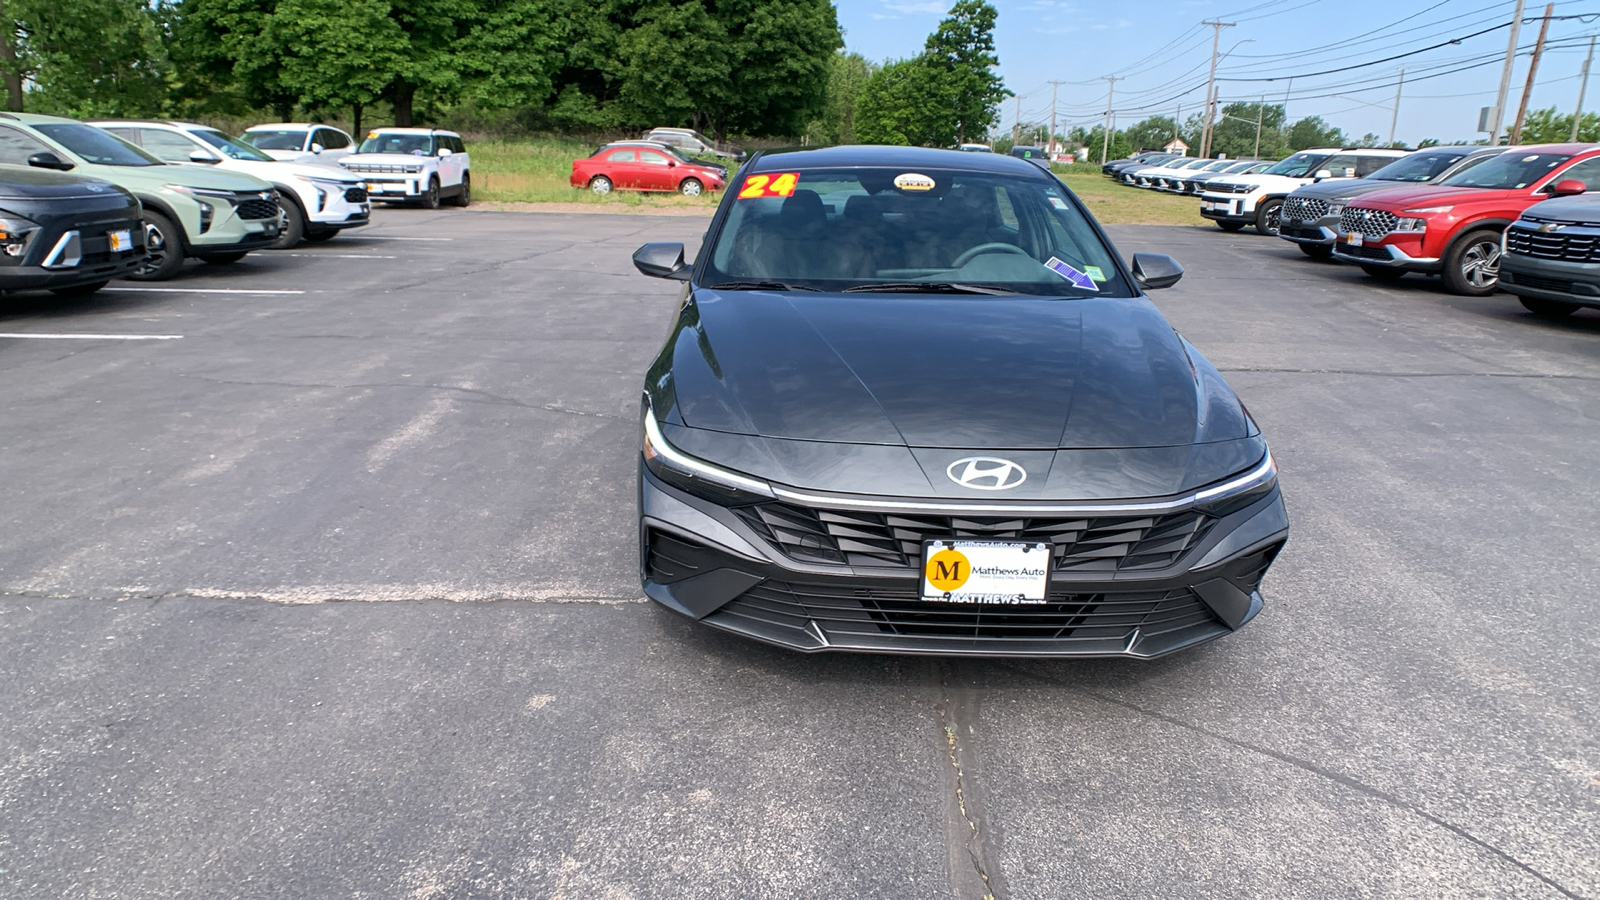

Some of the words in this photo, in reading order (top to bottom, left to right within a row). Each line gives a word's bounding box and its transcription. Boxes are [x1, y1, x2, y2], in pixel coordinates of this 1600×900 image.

[740, 173, 796, 198] 24
[952, 541, 1027, 550] MatthewsAuto.com
[932, 560, 962, 582] M
[971, 565, 1019, 576] Matthews
[1020, 567, 1046, 577] Auto
[949, 592, 1020, 605] MATTHEWS
